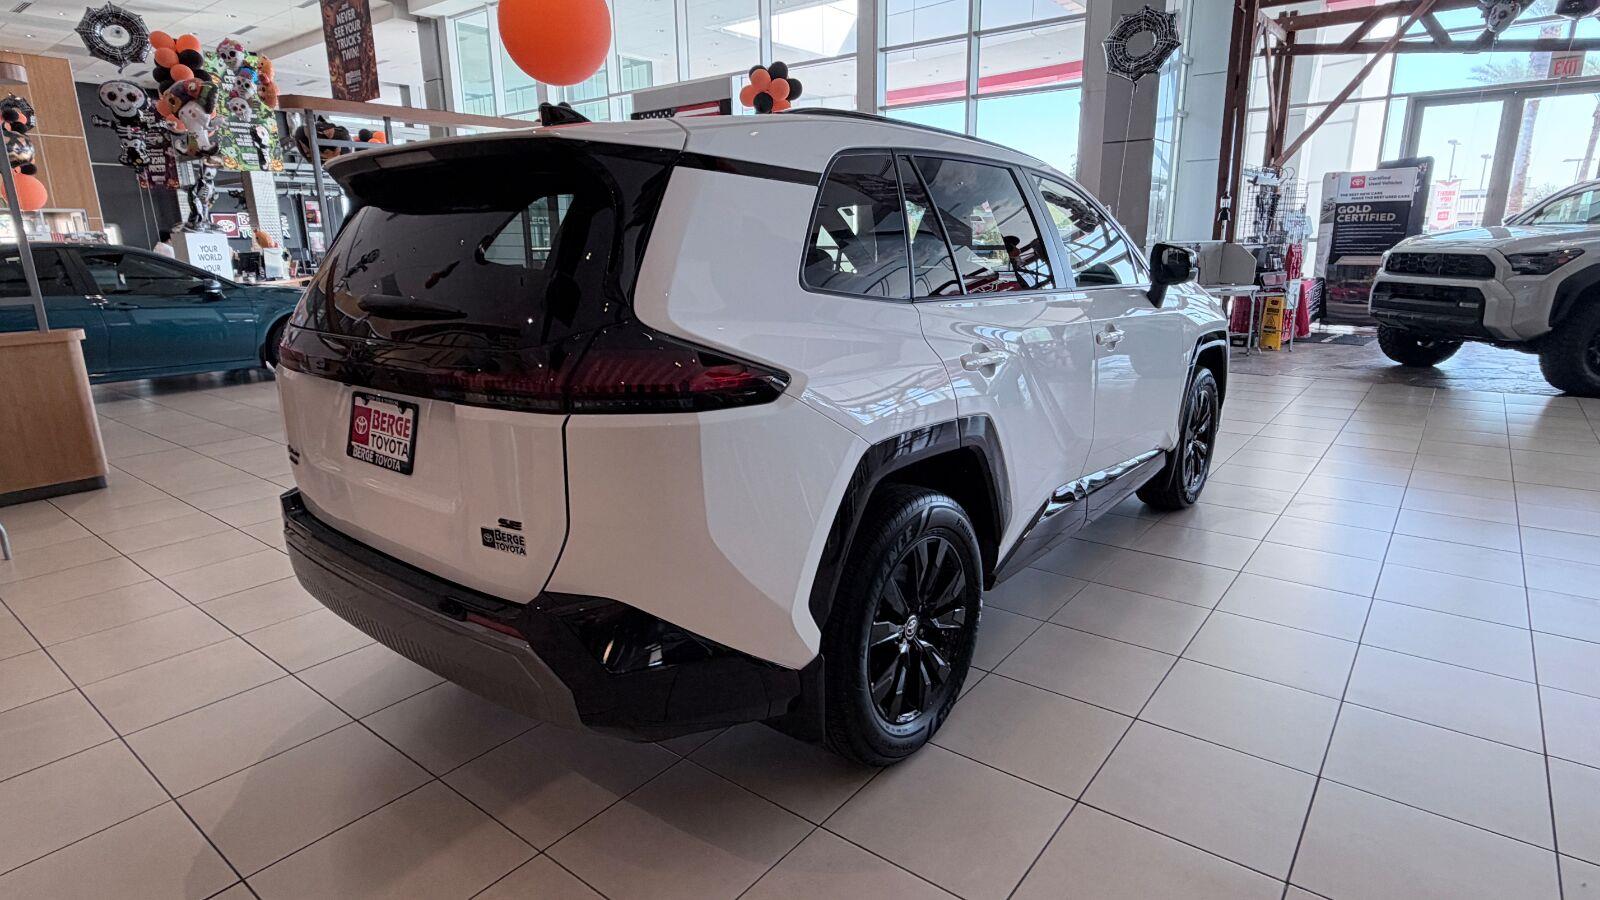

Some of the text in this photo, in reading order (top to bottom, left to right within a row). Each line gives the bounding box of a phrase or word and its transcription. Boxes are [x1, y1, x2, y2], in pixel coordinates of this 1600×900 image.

[336, 8, 356, 25] NEVER
[333, 19, 361, 38] SEE YOUR
[1554, 59, 1579, 76] EXIT
[1337, 204, 1372, 214] GOLD
[1336, 213, 1396, 223] CERTIFIED
[198, 253, 222, 261] WORLD
[372, 410, 411, 438] BERGE
[371, 433, 409, 457] TOYOTA
[353, 446, 400, 471] BERGE TOYOTA
[495, 529, 525, 546] BERGE
[496, 542, 527, 555] TOYOTA
